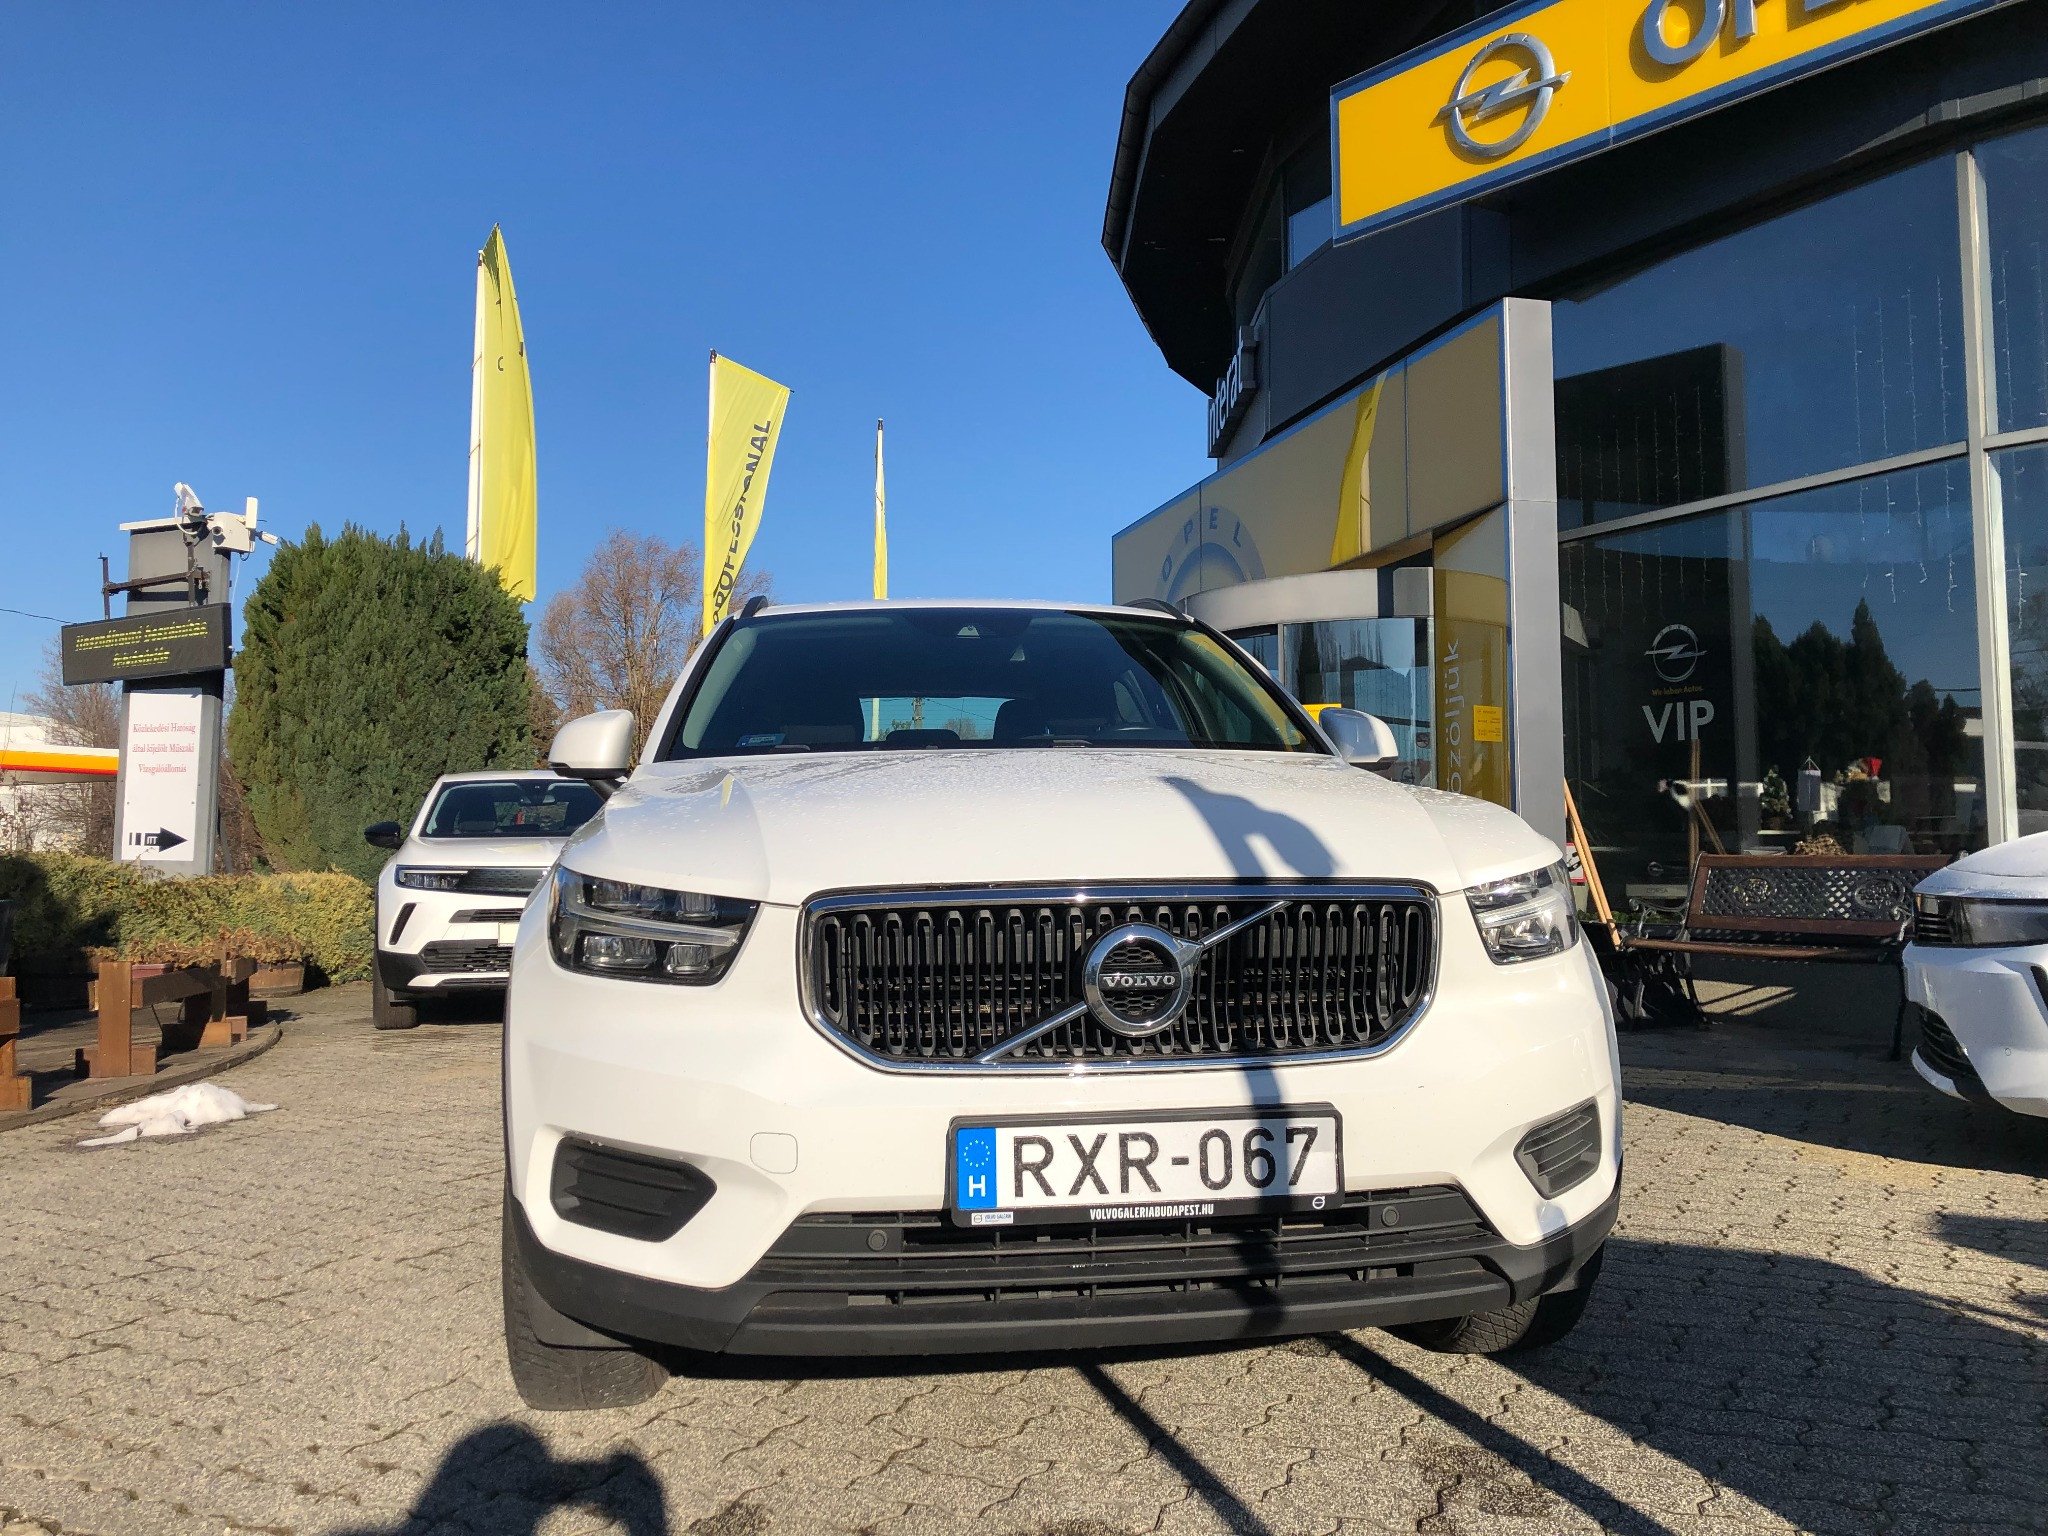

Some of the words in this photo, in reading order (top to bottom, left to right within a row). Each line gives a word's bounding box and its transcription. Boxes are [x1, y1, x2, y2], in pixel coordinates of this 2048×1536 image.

[1161, 507, 1242, 582] OPEL
[1641, 700, 1715, 744] VIP
[1103, 975, 1176, 988] VOLVO
[1013, 1126, 1319, 1198] RXR-067
[968, 1174, 986, 1198] H
[1090, 1203, 1215, 1221] VOLVOGALERIABUDAPEST.HU
